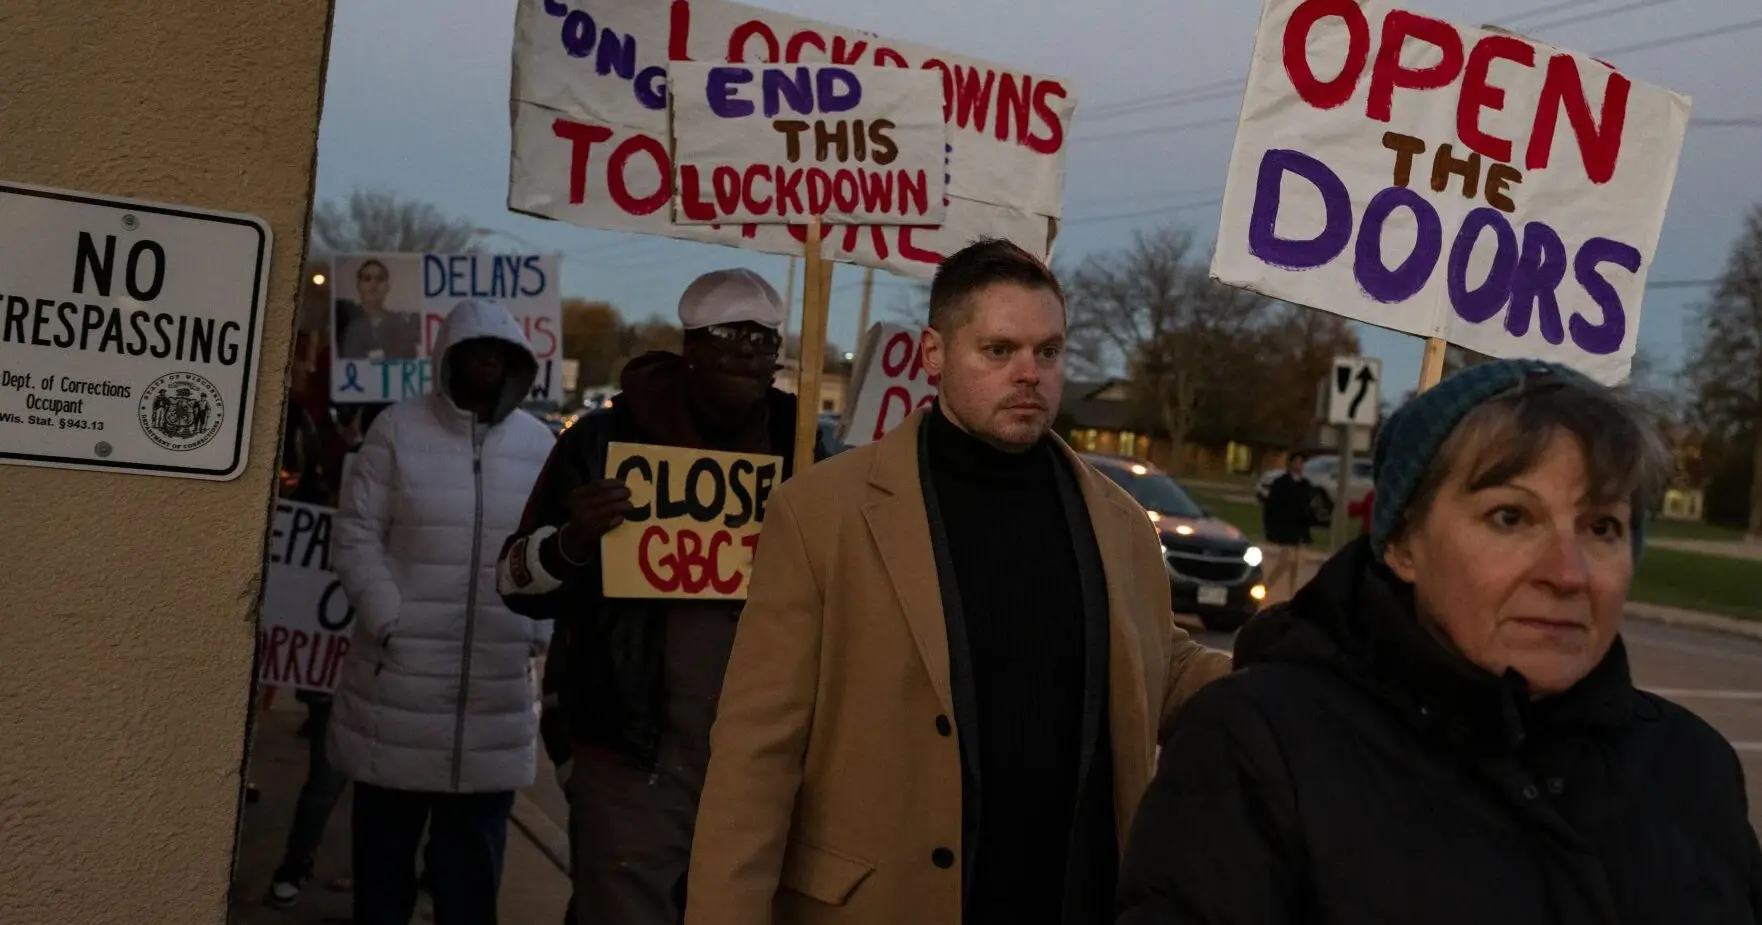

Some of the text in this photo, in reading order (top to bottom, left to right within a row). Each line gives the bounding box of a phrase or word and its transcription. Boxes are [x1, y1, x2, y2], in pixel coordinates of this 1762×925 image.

[544, 0, 667, 110] ONG
[706, 67, 862, 117] END
[1283, 0, 1631, 184] OPEN
[773, 118, 899, 165] THIS
[680, 164, 928, 221] LOCKDOWN
[1382, 131, 1523, 213] THE
[73, 231, 166, 301] NO
[424, 254, 545, 298] DELAYS
[1248, 149, 1642, 355] DOORS
[0, 294, 241, 366] RESPASSING
[2, 370, 131, 399] Dept. of Corrections
[26, 393, 83, 416] Occupant
[0, 411, 104, 431] Wis. Stat. §943.13
